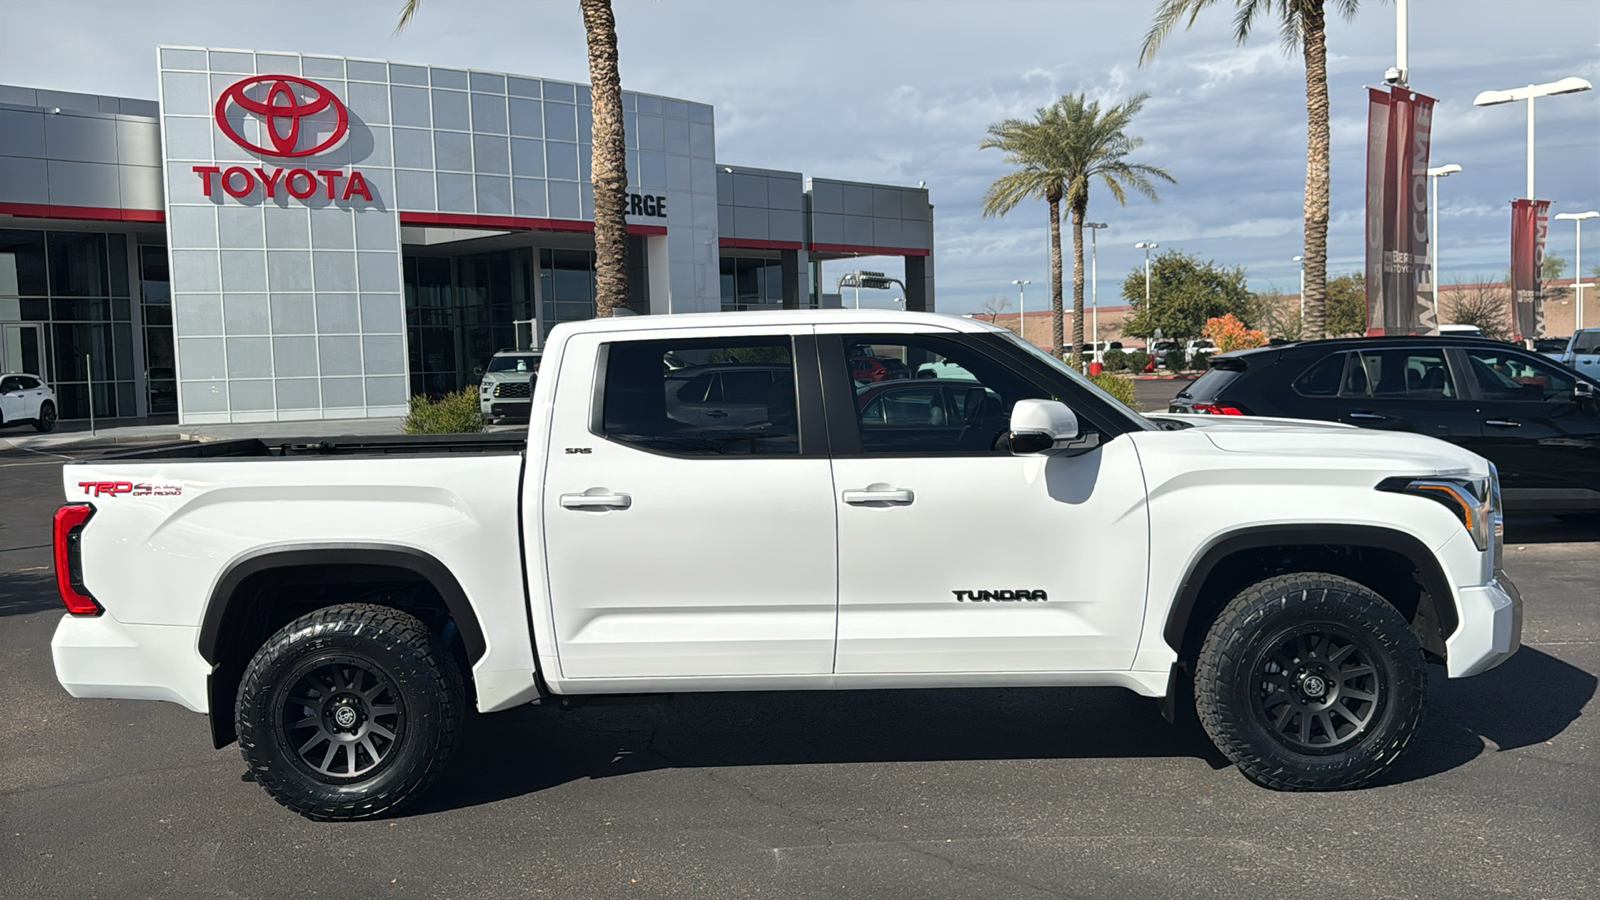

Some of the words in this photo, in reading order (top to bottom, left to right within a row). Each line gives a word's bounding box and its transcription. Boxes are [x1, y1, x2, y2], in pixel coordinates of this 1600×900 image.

[192, 166, 373, 201] TOYOTA
[625, 193, 667, 217] ERGE
[1413, 102, 1438, 335] WELCOME
[1534, 204, 1548, 338] WELCOME
[78, 481, 133, 497] TRD
[951, 589, 1047, 602] TUNDRA
